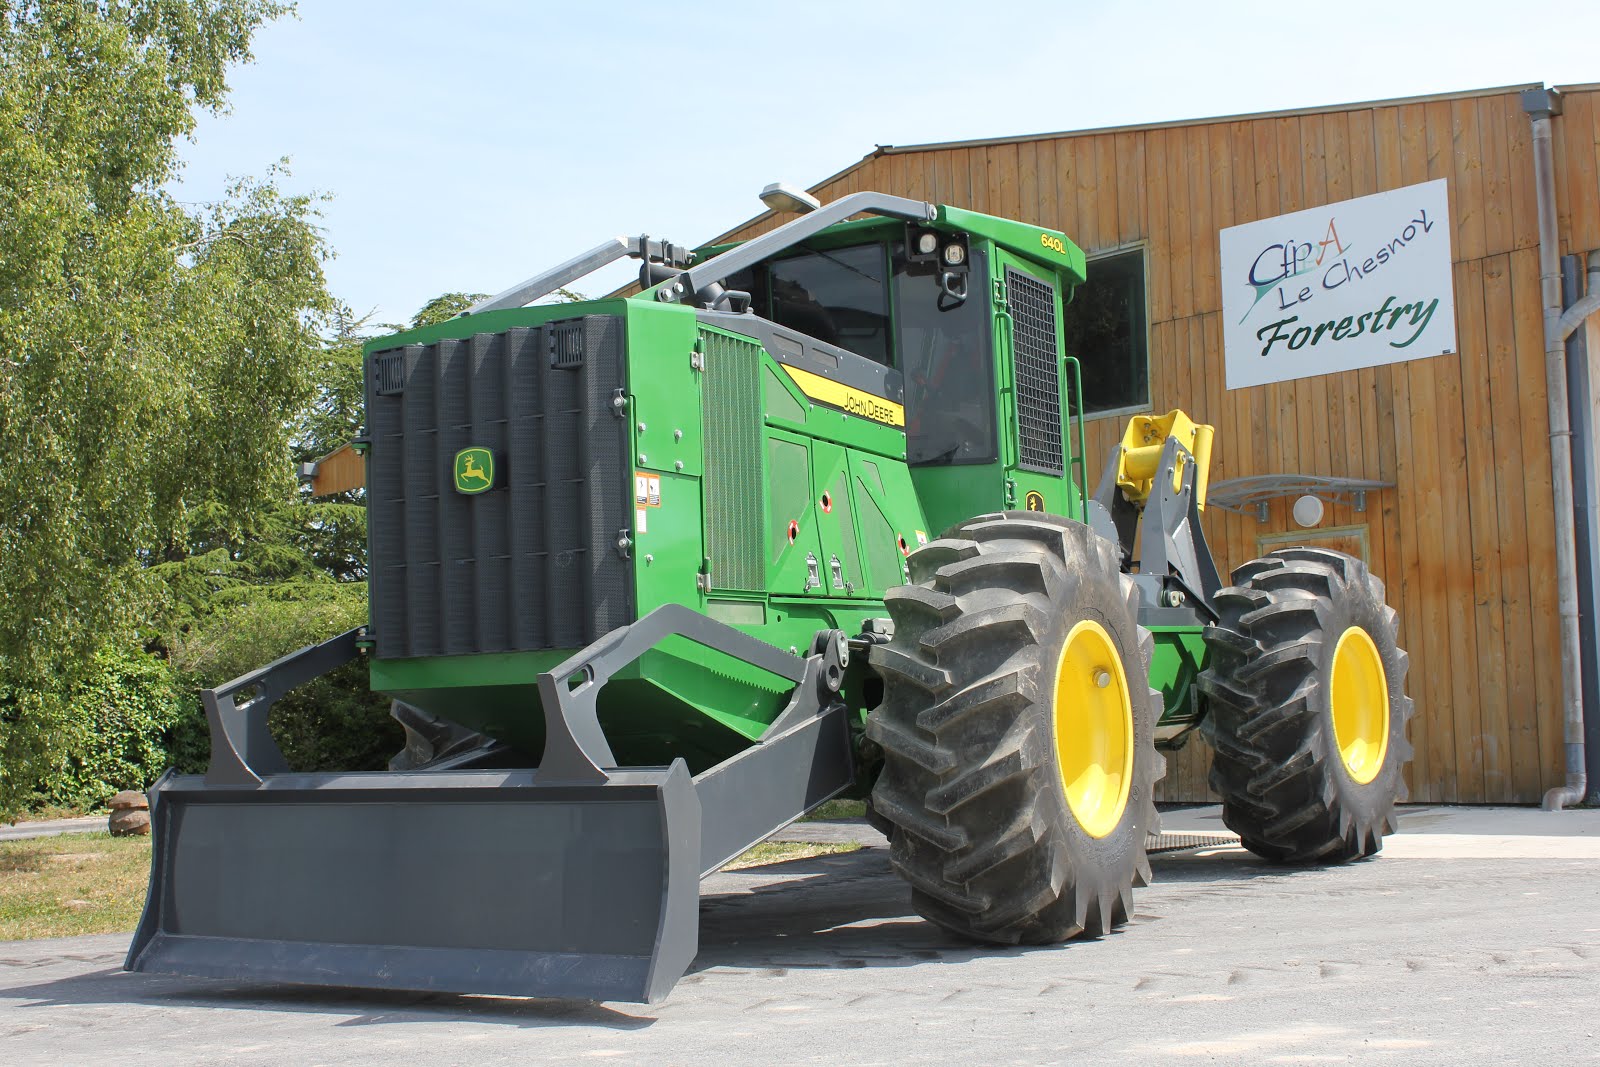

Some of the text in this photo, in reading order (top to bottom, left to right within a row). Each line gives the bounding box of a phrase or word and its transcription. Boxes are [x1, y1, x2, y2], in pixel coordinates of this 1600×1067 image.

[1041, 233, 1066, 255] 640L
[1278, 209, 1434, 312] Le Chesnoy
[1256, 295, 1440, 357] Forestry
[843, 392, 895, 423] JOHN DEERE
